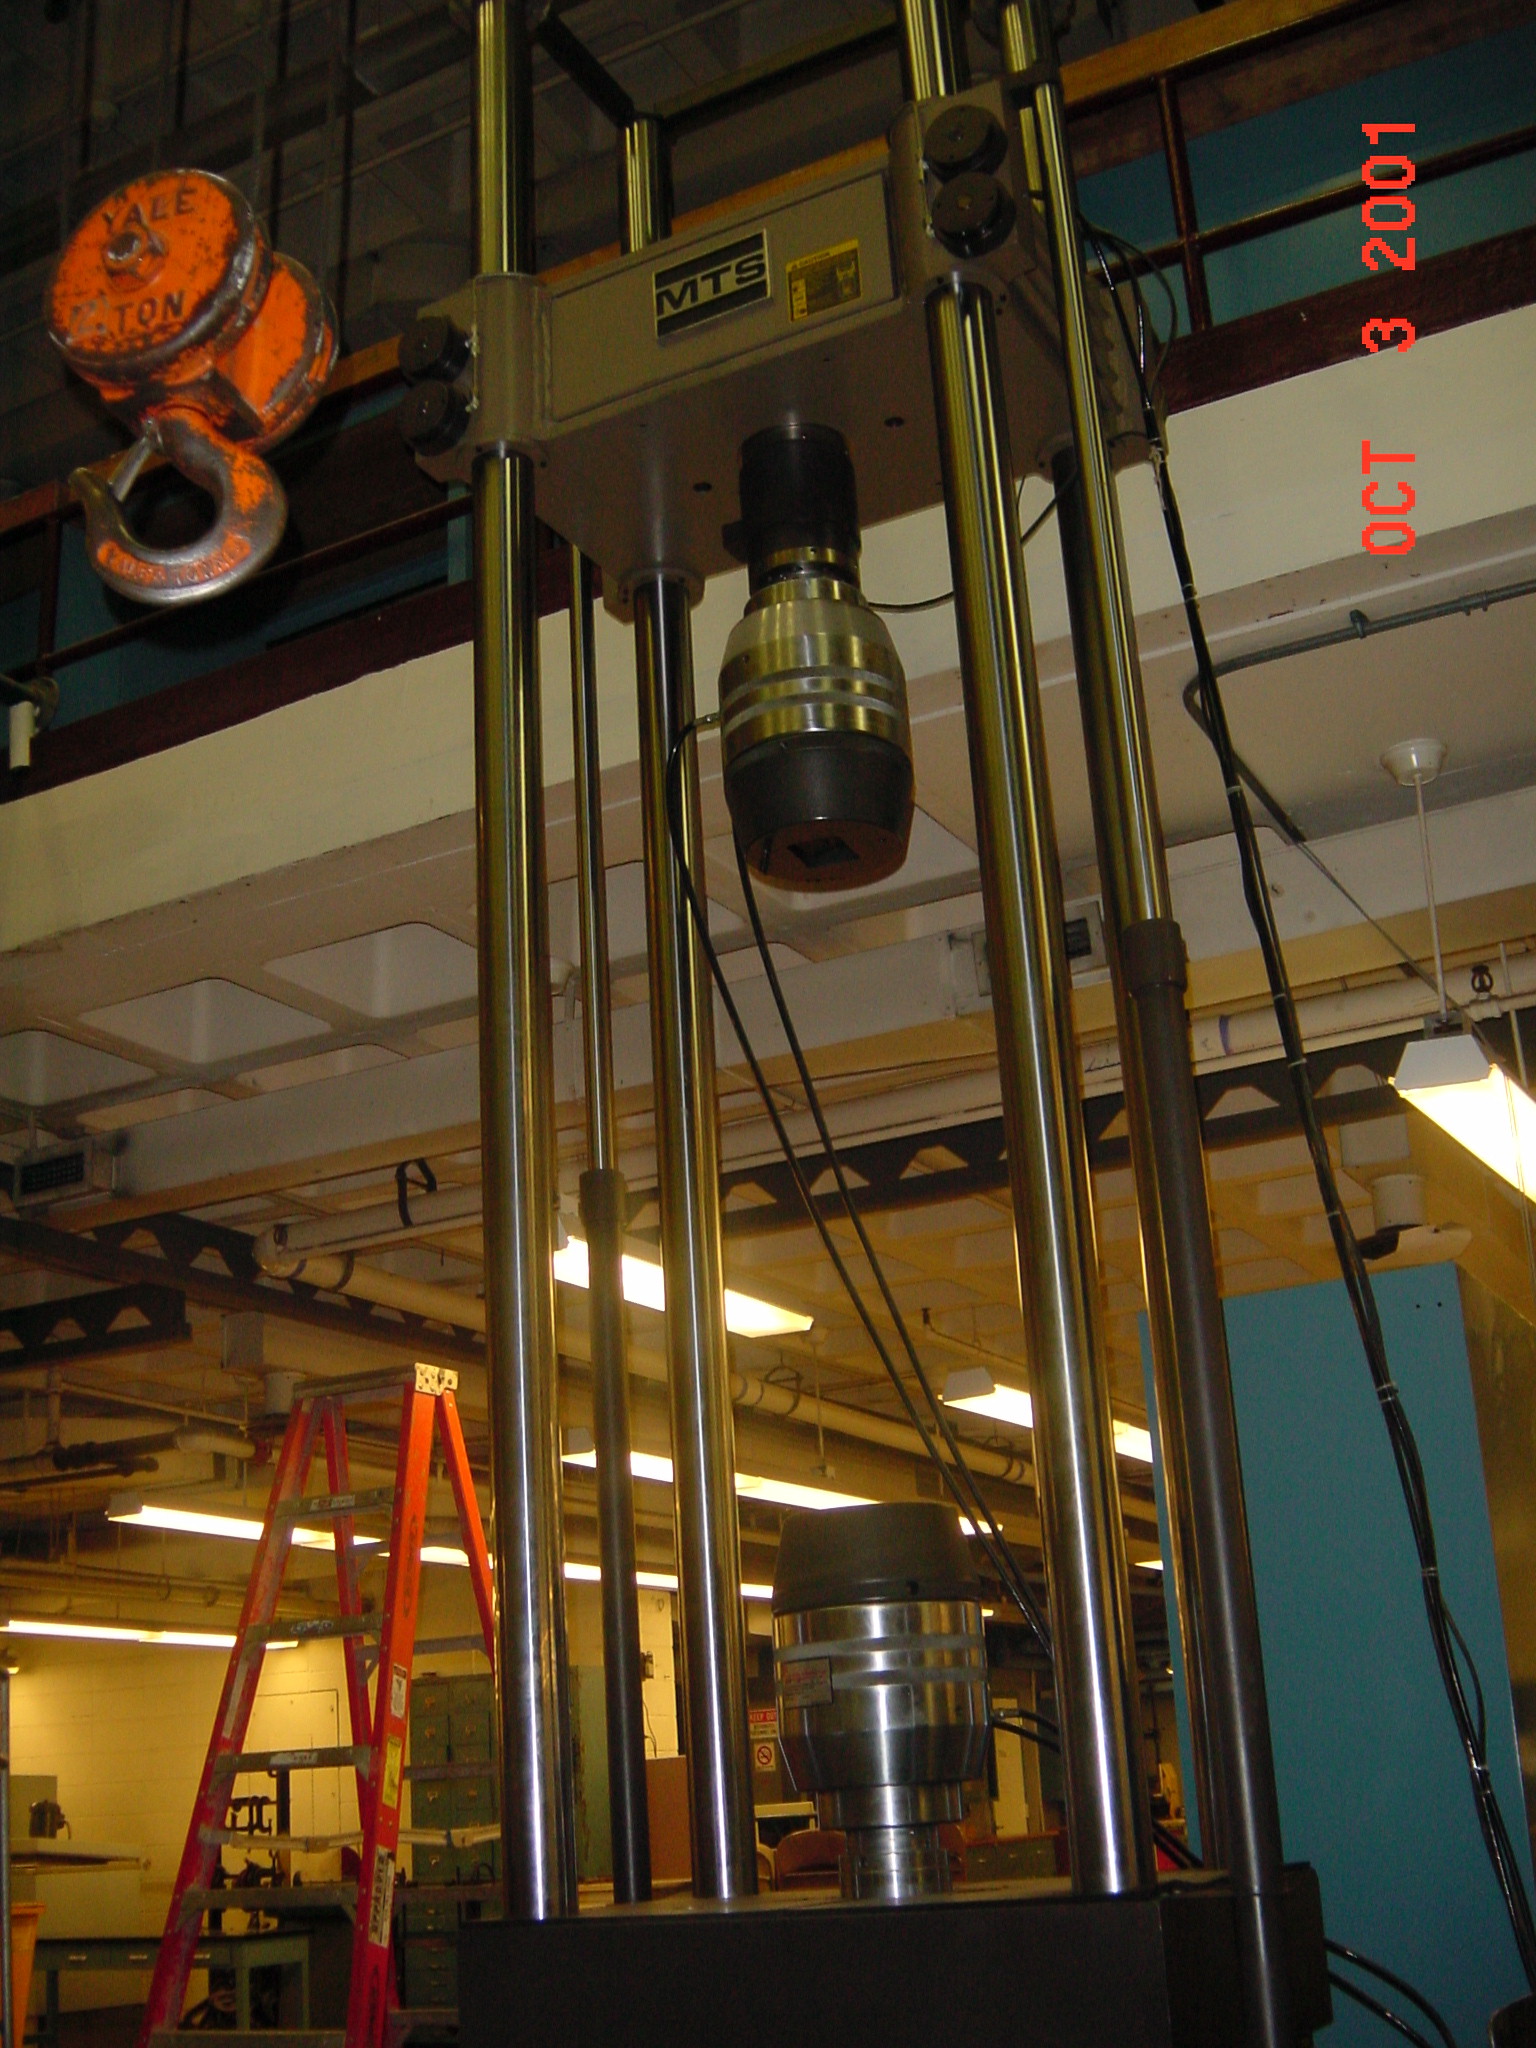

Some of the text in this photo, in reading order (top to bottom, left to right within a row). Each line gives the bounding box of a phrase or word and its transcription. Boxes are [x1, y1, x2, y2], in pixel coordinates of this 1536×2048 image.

[102, 187, 198, 233] YALE
[655, 253, 767, 317] MTS
[112, 290, 187, 333] TON
